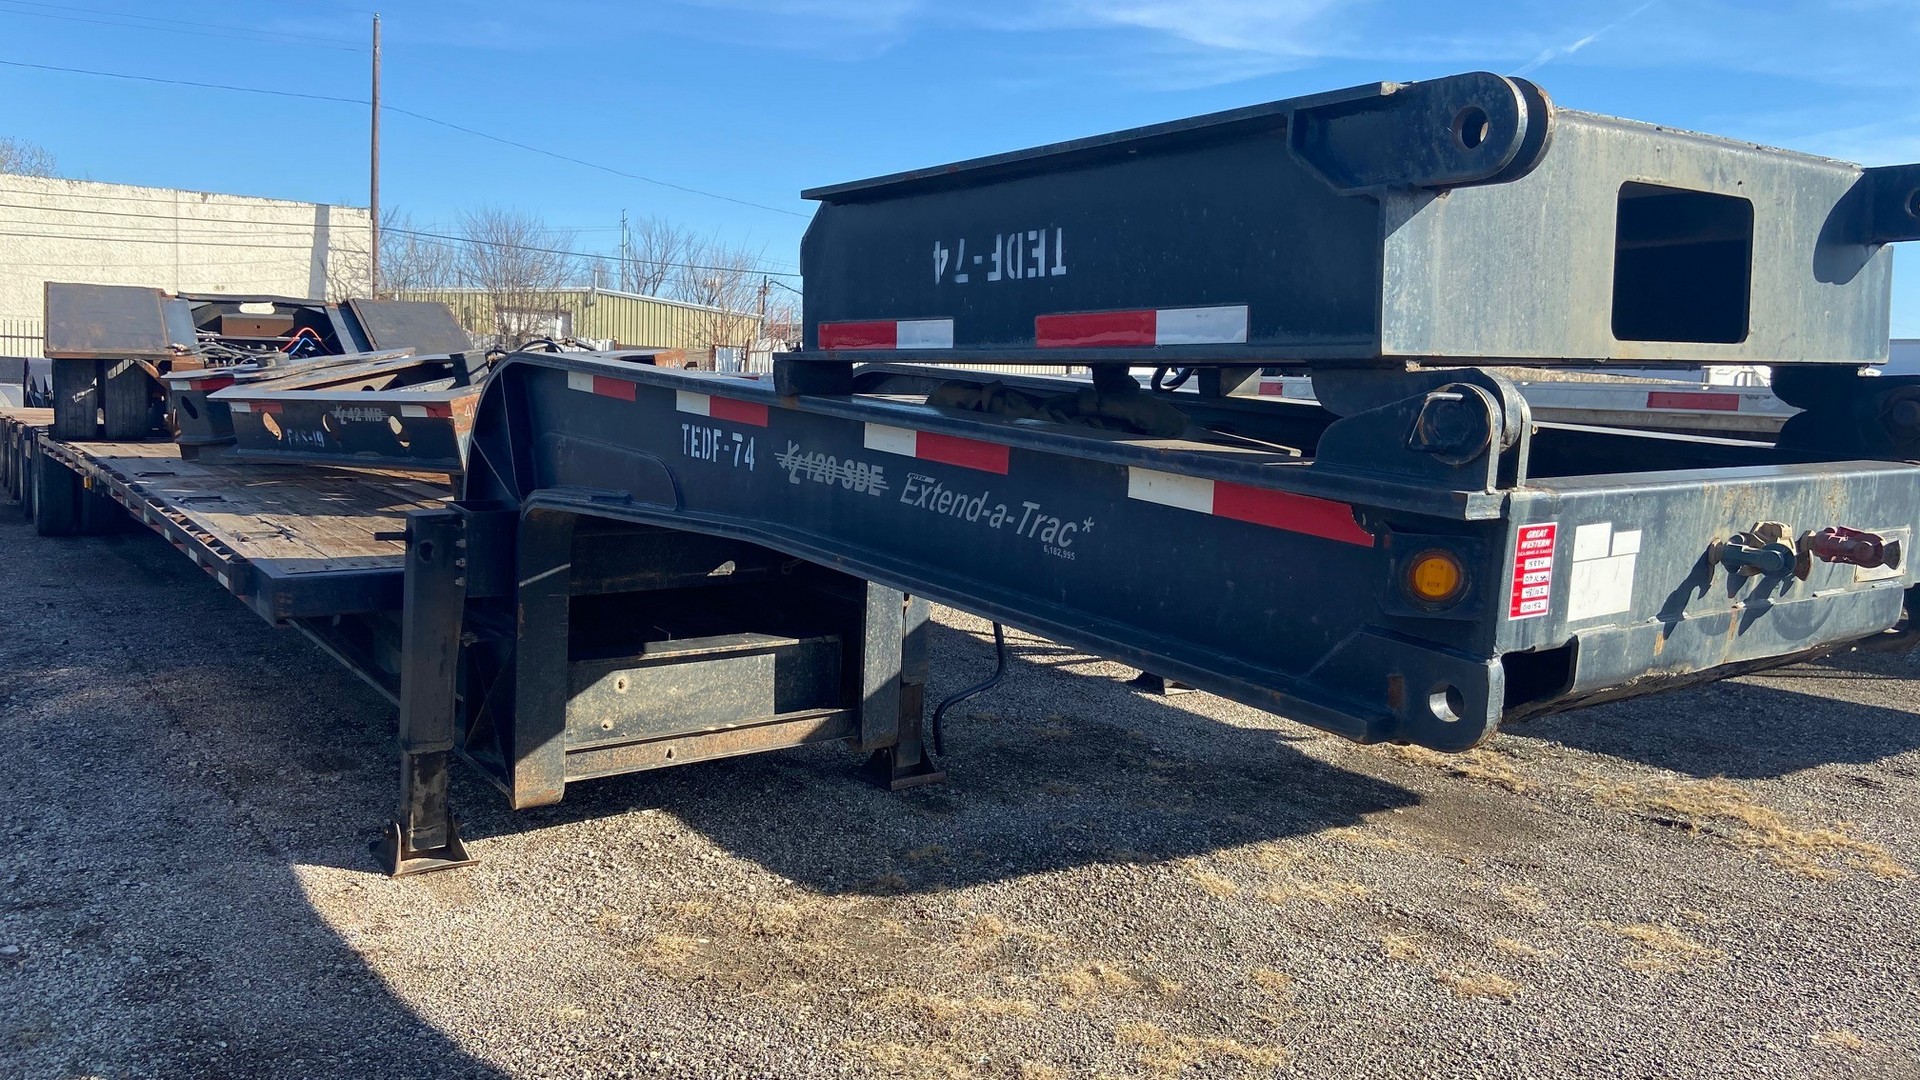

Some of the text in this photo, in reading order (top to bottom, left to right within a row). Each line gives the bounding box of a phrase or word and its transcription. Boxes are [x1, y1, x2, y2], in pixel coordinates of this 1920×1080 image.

[933, 227, 1067, 285] TEDF-74
[681, 423, 755, 472] TEDF-74
[804, 450, 837, 485] 120
[840, 458, 888, 497] SDE
[1520, 538, 1552, 550] WESTERN
[1526, 529, 1549, 539] GREAT
[1043, 544, 1076, 561] 6,182,995
